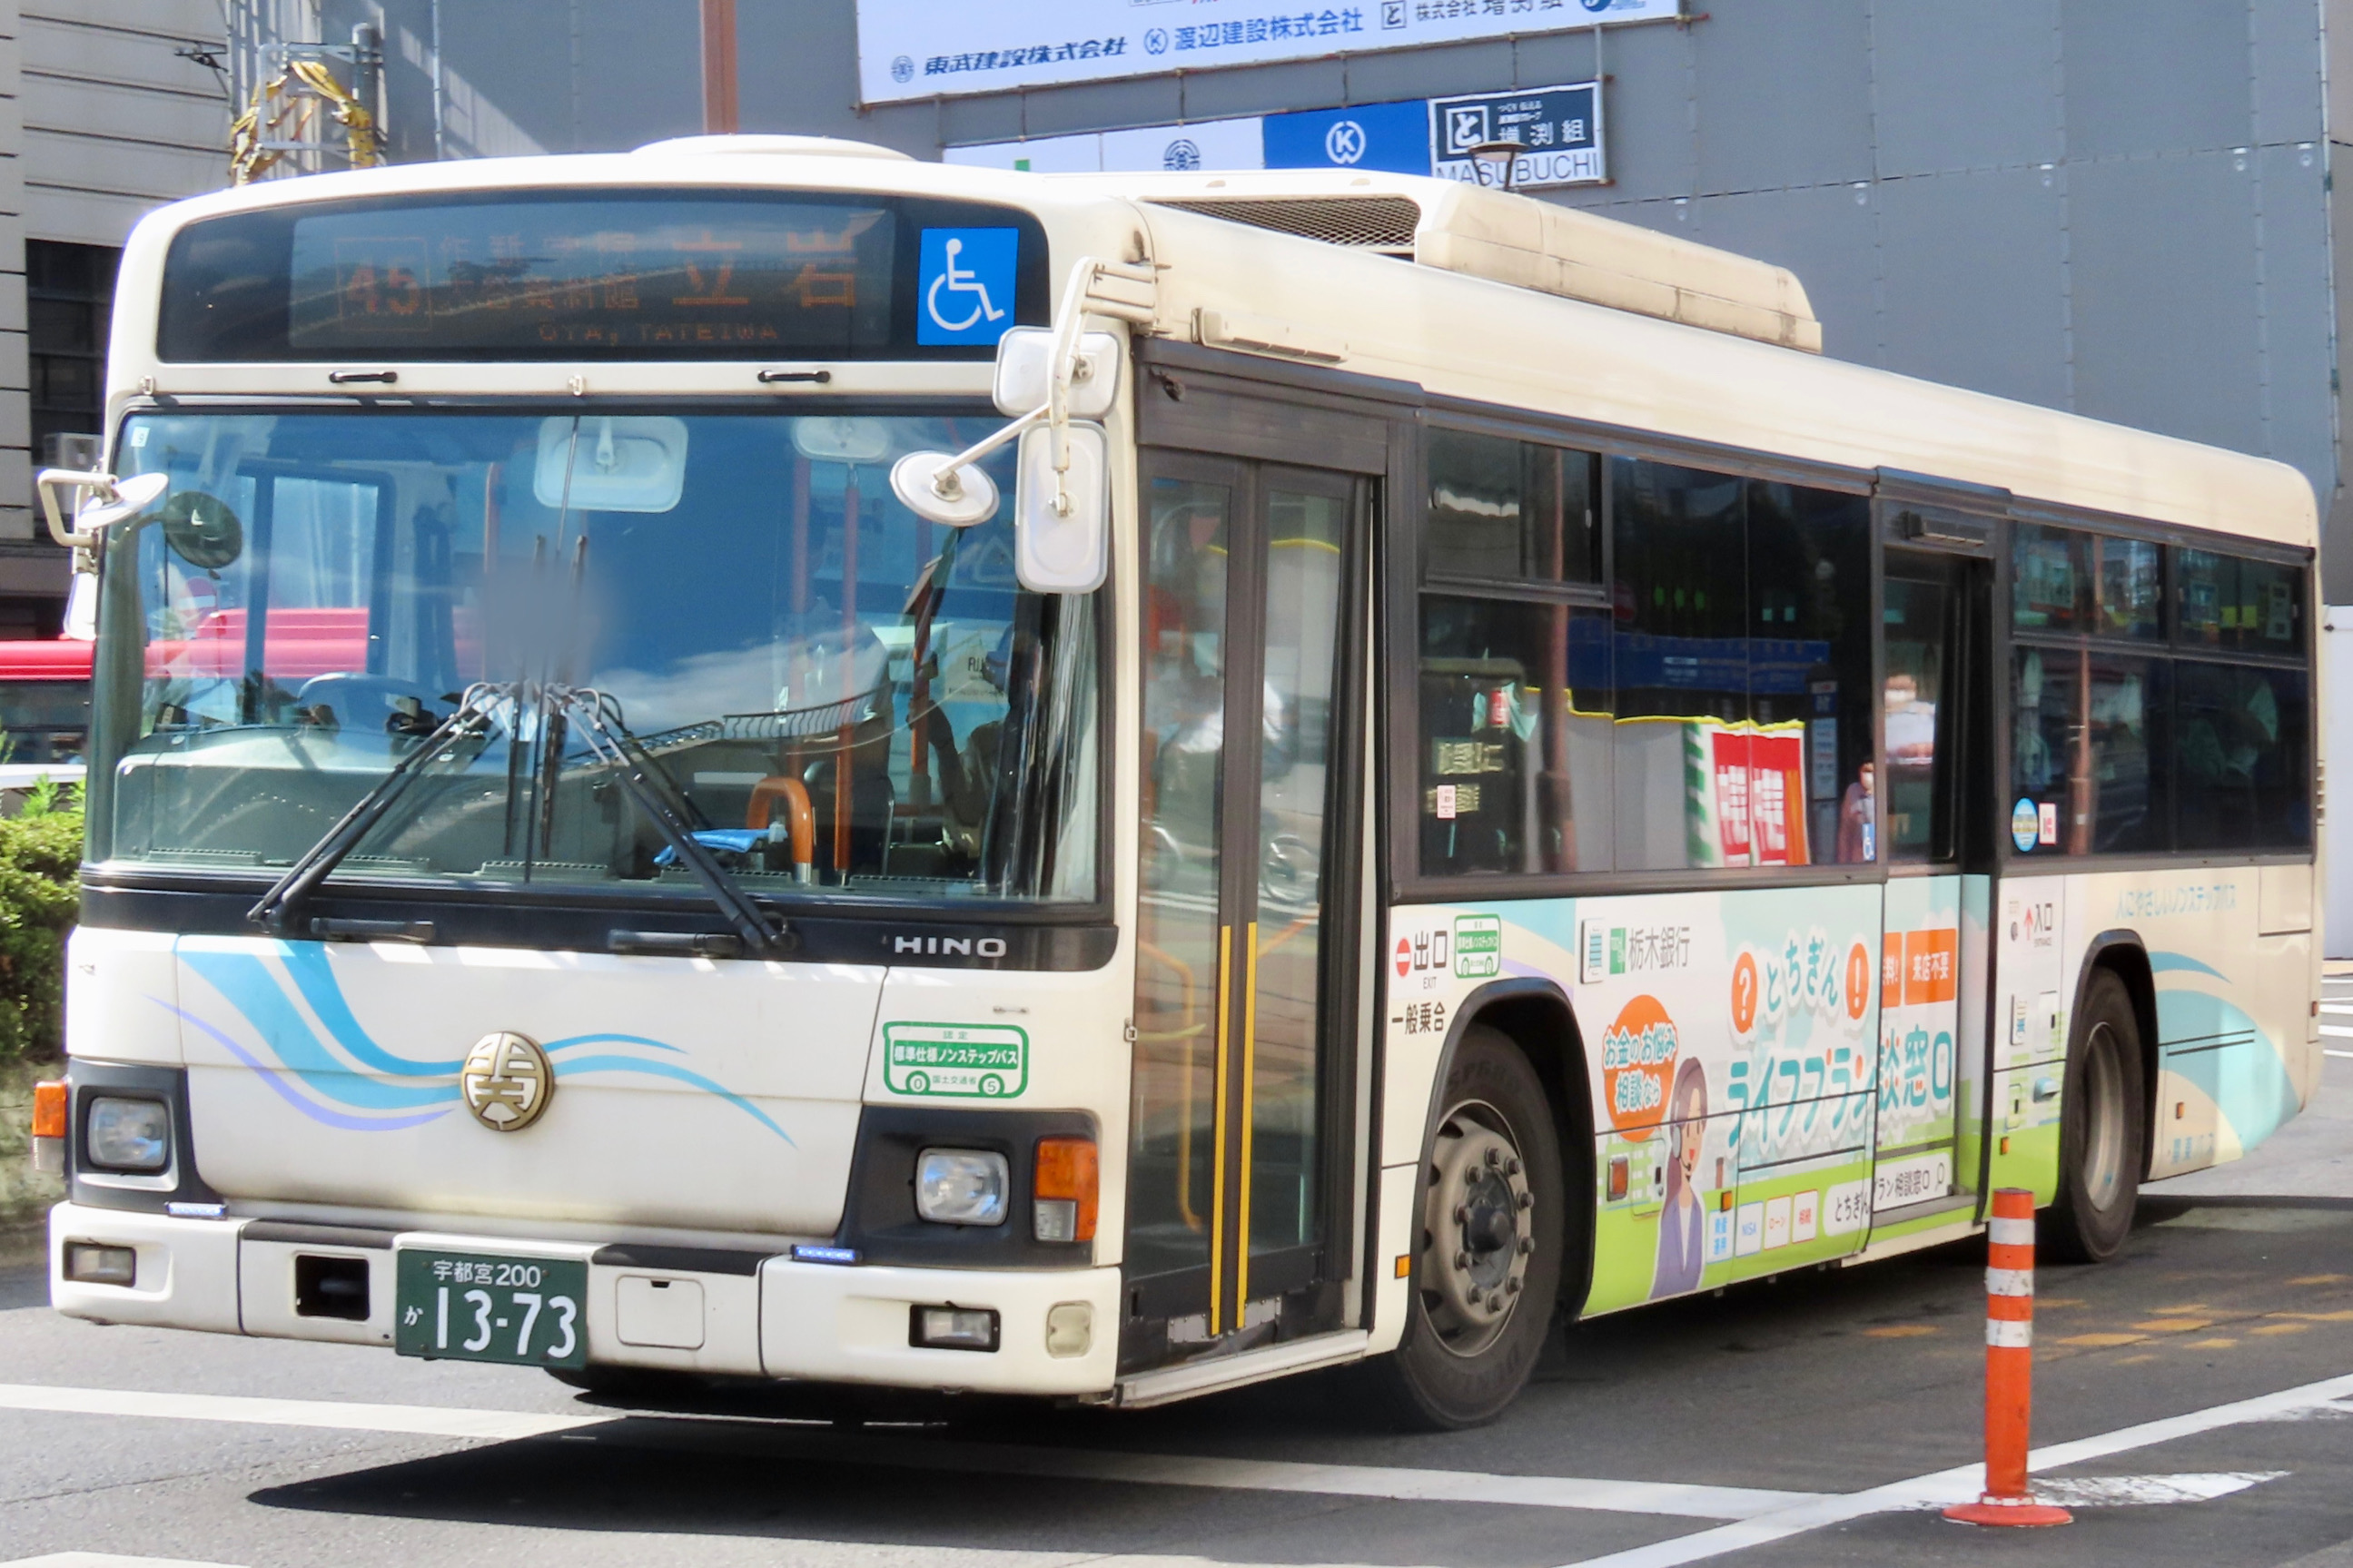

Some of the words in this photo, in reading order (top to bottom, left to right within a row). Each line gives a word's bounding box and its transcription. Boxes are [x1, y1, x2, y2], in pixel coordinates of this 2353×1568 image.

[1174, 7, 1364, 51] 渡辺建設株式会社
[924, 36, 1128, 75] 東武建設株式会社
[2033, 902, 2054, 933] 入口
[895, 936, 1007, 958] HINO
[1413, 930, 1448, 971] 出口
[1628, 926, 1690, 971] 栃木銀行
[1423, 976, 1437, 990] EXIT
[1766, 936, 1838, 1012] とちぎん
[1913, 951, 1950, 981] 来店不要
[943, 1030, 969, 1040] 認定
[1391, 1001, 1446, 1035] 一般乗合
[894, 1044, 1018, 1066] 標準仕様ノンステップバス
[1603, 1024, 1677, 1070] お金のお悩み
[932, 1074, 977, 1086] 国土交通省
[1616, 1070, 1662, 1111] 相談なら
[403, 1305, 424, 1326] か
[436, 1287, 578, 1359] 13-73
